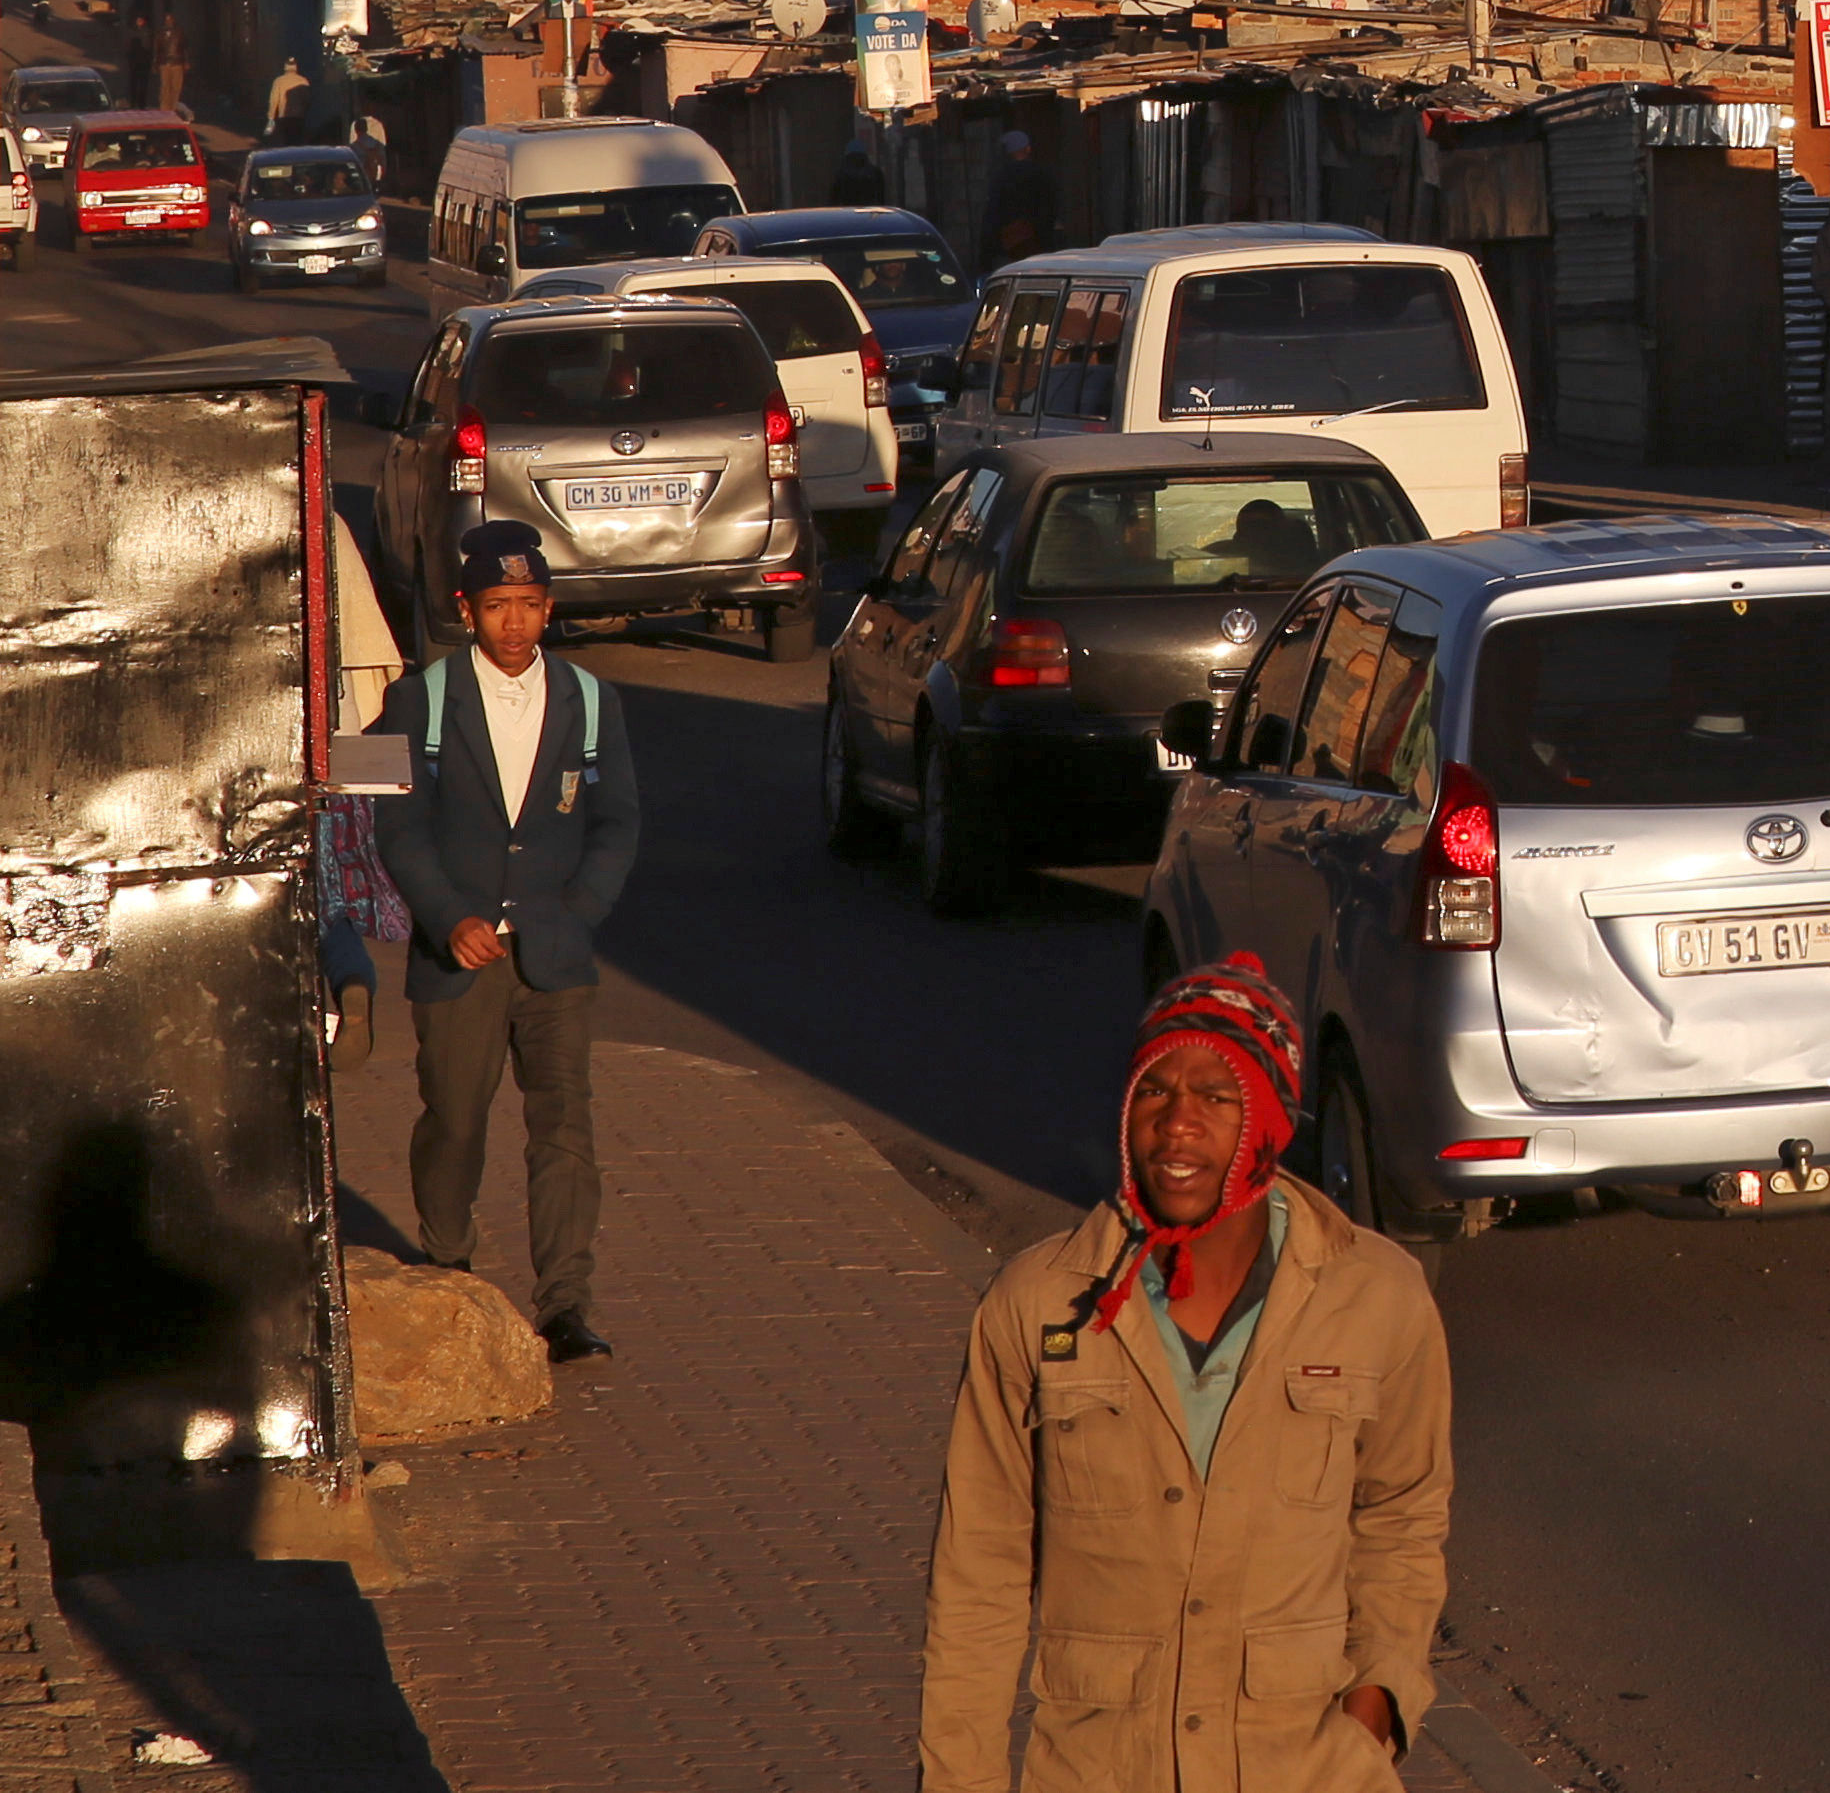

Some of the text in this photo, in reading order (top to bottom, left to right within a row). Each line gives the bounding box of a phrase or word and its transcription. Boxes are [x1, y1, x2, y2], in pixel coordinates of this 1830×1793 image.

[891, 19, 908, 27] DA
[866, 32, 918, 50] VOTE DA
[572, 482, 688, 504] CM 30 WM GP
[1674, 927, 1714, 967] CV
[1724, 925, 1762, 965] 51
[1773, 922, 1811, 960] GV
